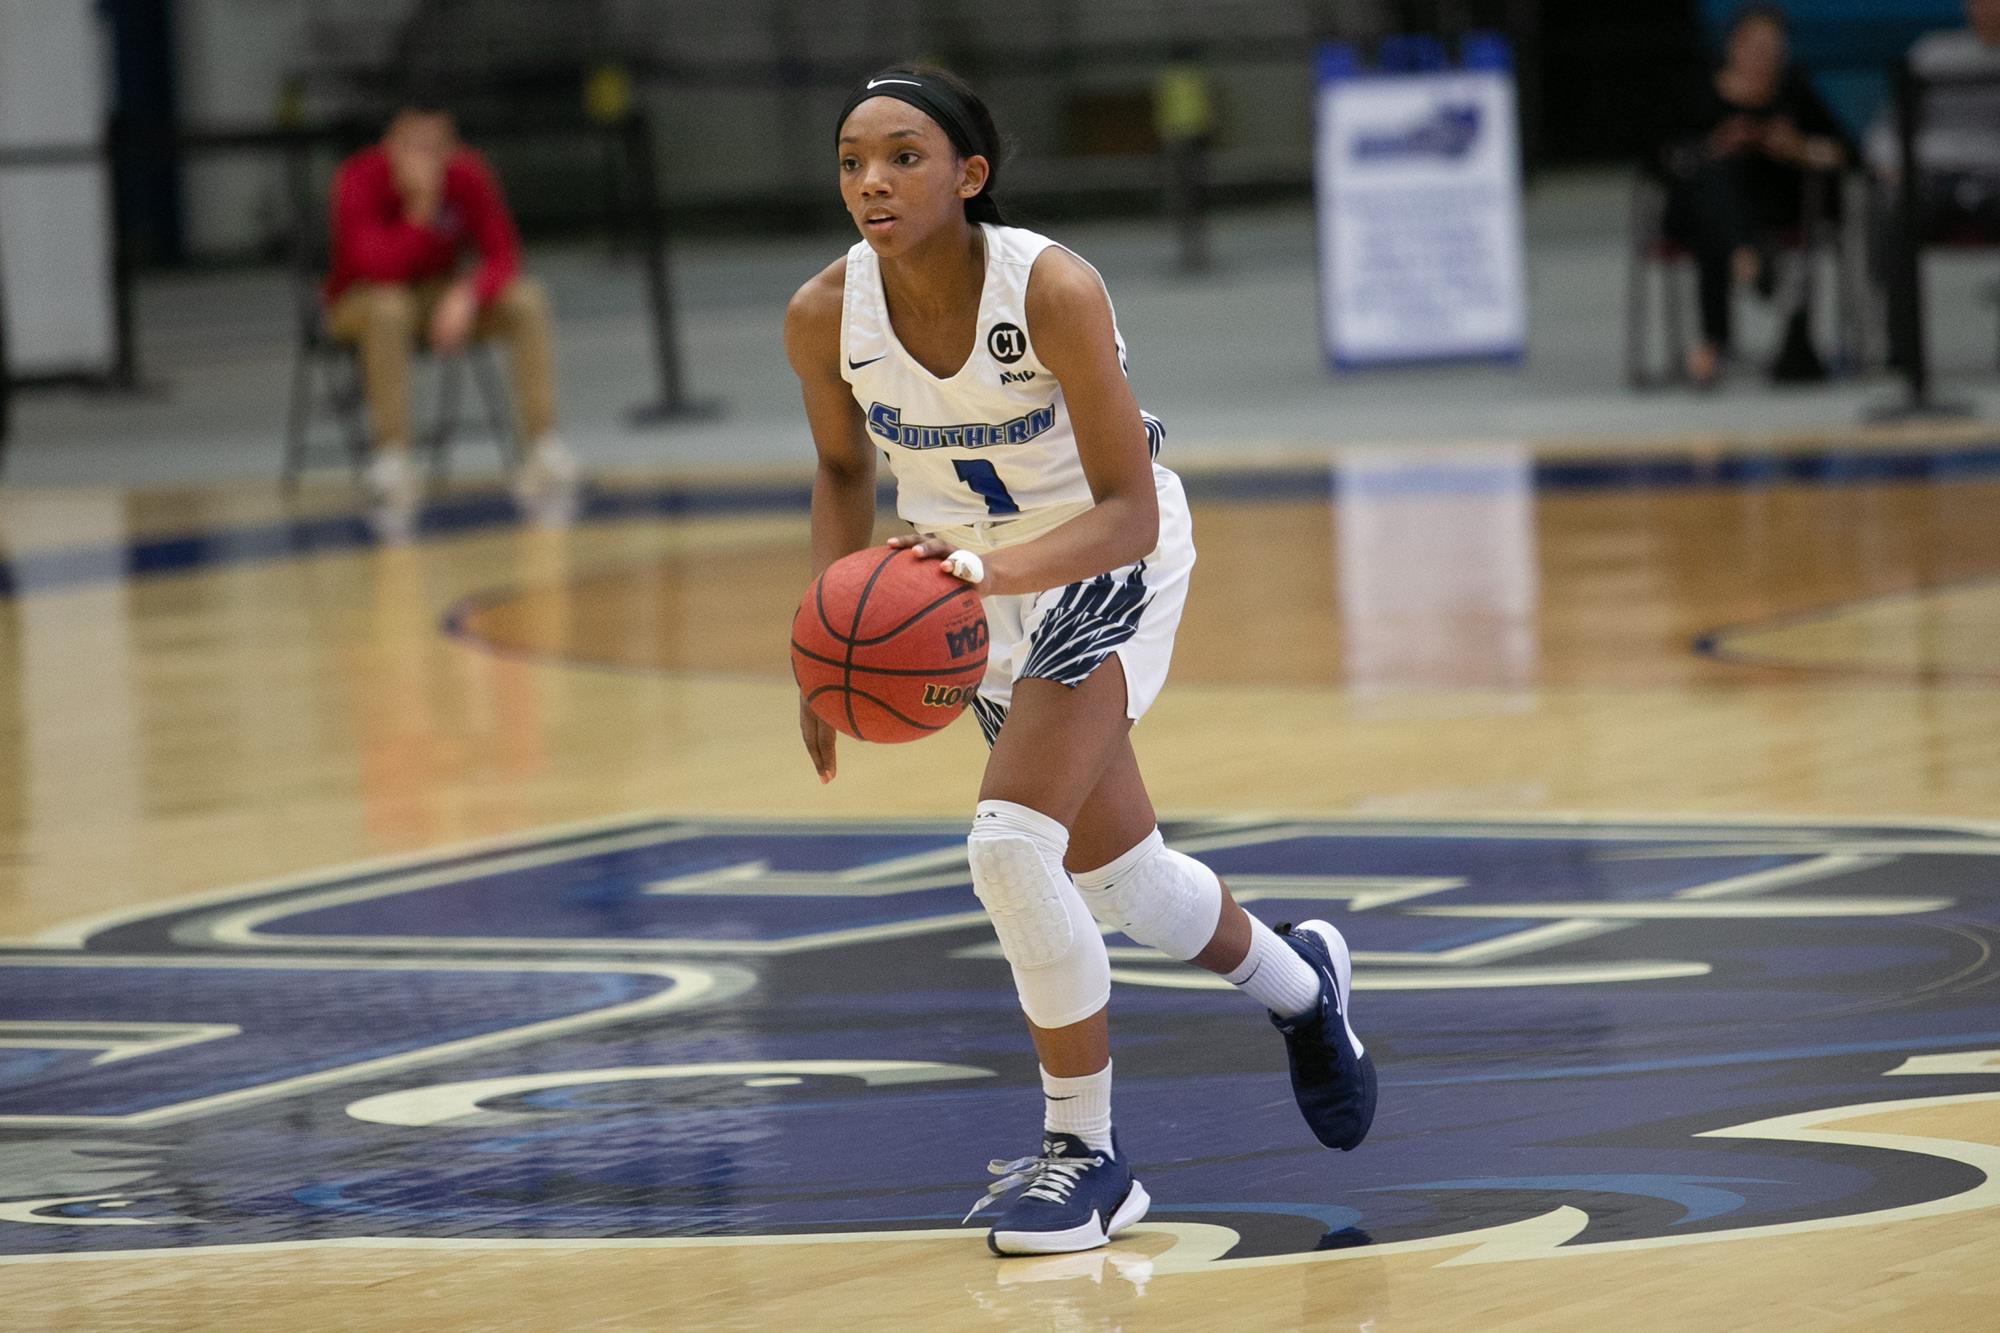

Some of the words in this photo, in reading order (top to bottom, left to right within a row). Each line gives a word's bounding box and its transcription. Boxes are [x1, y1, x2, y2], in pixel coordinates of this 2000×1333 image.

[990, 328, 1023, 359] CI
[868, 401, 1055, 451] SOUTHERN
[951, 458, 1020, 515] 1
[945, 618, 989, 660] CAA
